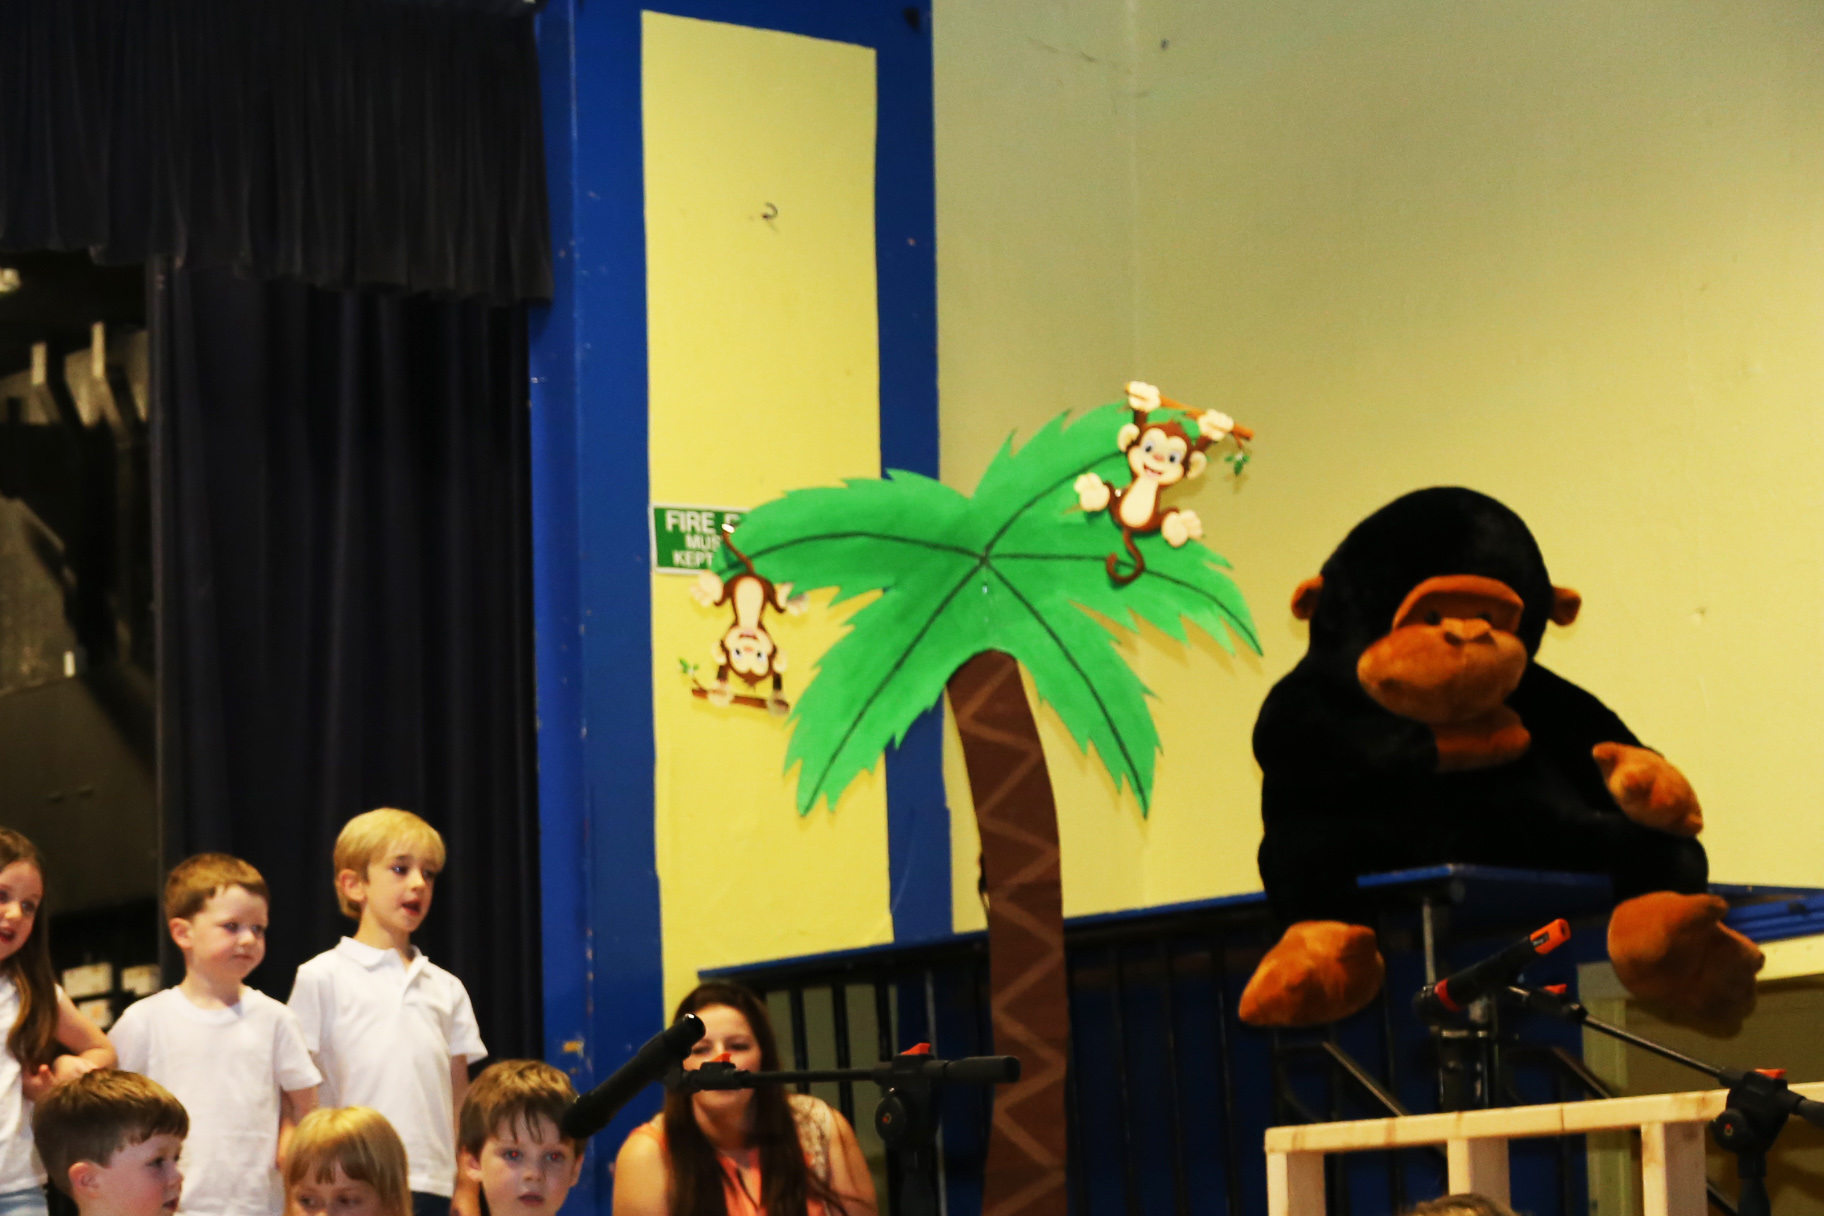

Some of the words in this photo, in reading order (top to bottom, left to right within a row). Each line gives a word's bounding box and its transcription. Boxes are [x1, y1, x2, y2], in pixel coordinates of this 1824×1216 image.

[665, 509, 717, 533] FIRE
[685, 534, 722, 551] MUS
[671, 550, 714, 568] KEPT
